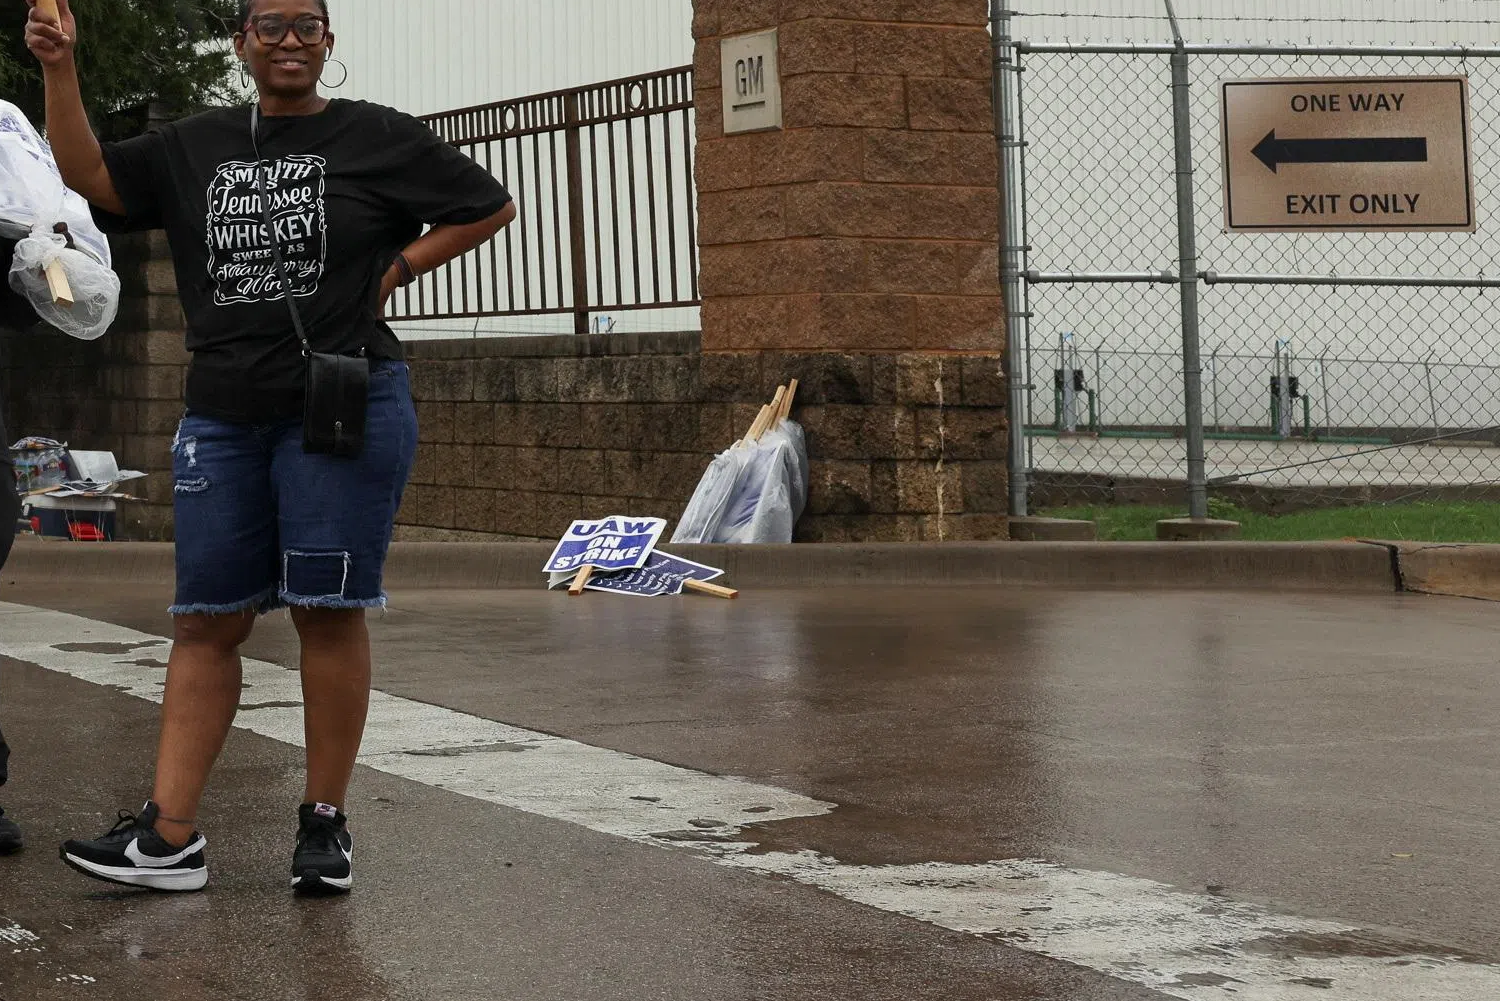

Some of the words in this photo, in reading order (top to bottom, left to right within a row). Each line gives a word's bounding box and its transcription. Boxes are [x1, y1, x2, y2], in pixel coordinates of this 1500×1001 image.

[735, 55, 764, 97] GM
[1291, 94, 1341, 112] ONE
[1348, 93, 1405, 111] WAY
[1286, 194, 1341, 215] EXIT
[1350, 193, 1420, 214] ONLY
[214, 213, 315, 250] WHISKEY
[232, 246, 281, 262] SWEE
[237, 273, 293, 295] Win
[572, 520, 658, 536] UAW
[587, 536, 622, 550] ON
[554, 546, 641, 569] STRIKE
